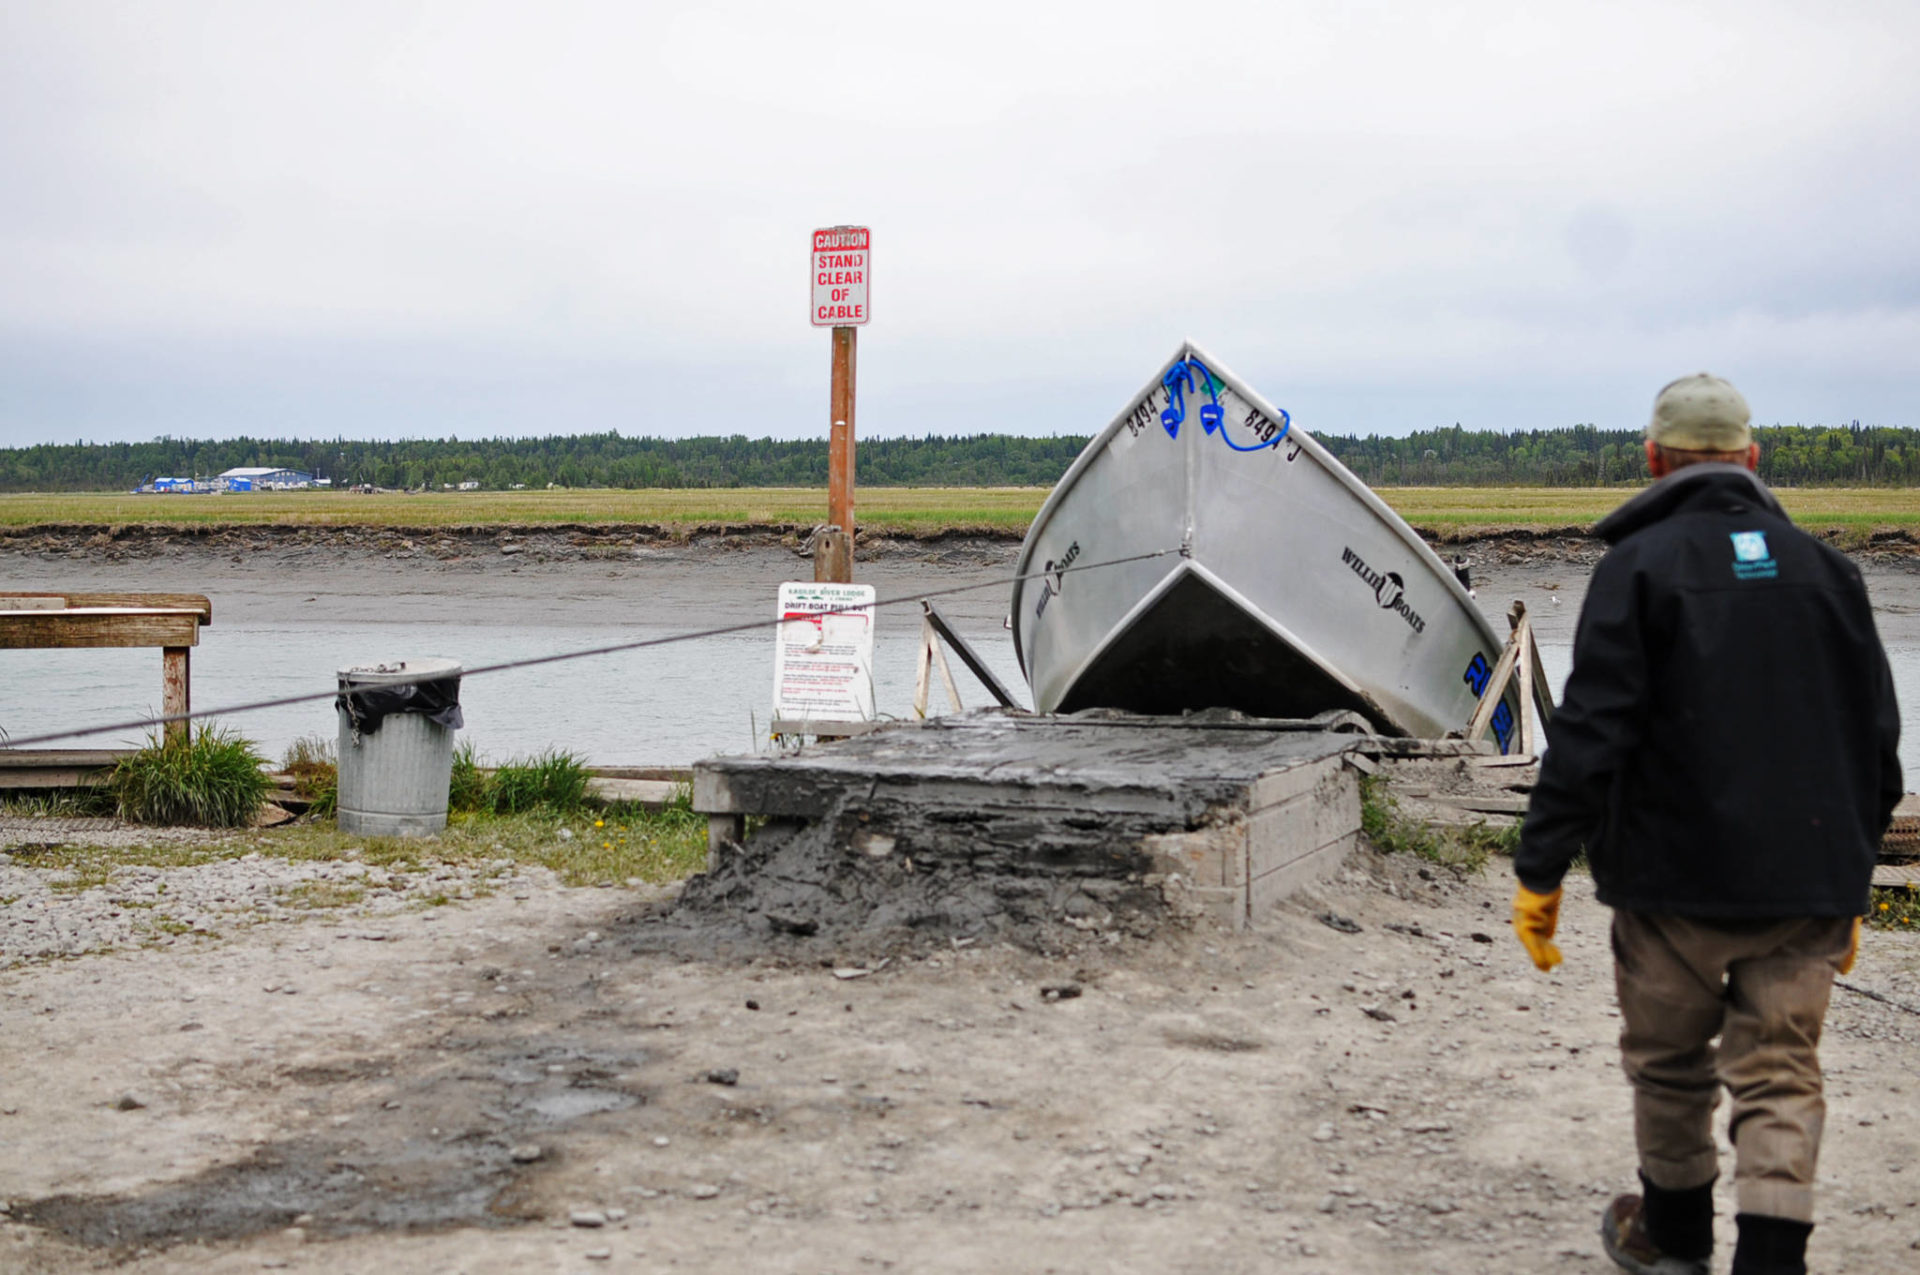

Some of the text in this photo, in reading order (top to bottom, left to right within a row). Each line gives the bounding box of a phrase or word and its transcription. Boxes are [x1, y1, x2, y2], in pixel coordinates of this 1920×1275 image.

[816, 232, 867, 249] CAUTION
[819, 254, 863, 269] STAND
[818, 271, 862, 285] CLEAR
[831, 288, 850, 302] OF
[818, 304, 862, 319] CABLE
[784, 602, 807, 610] DRIFT
[1393, 598, 1426, 634] BOATS
